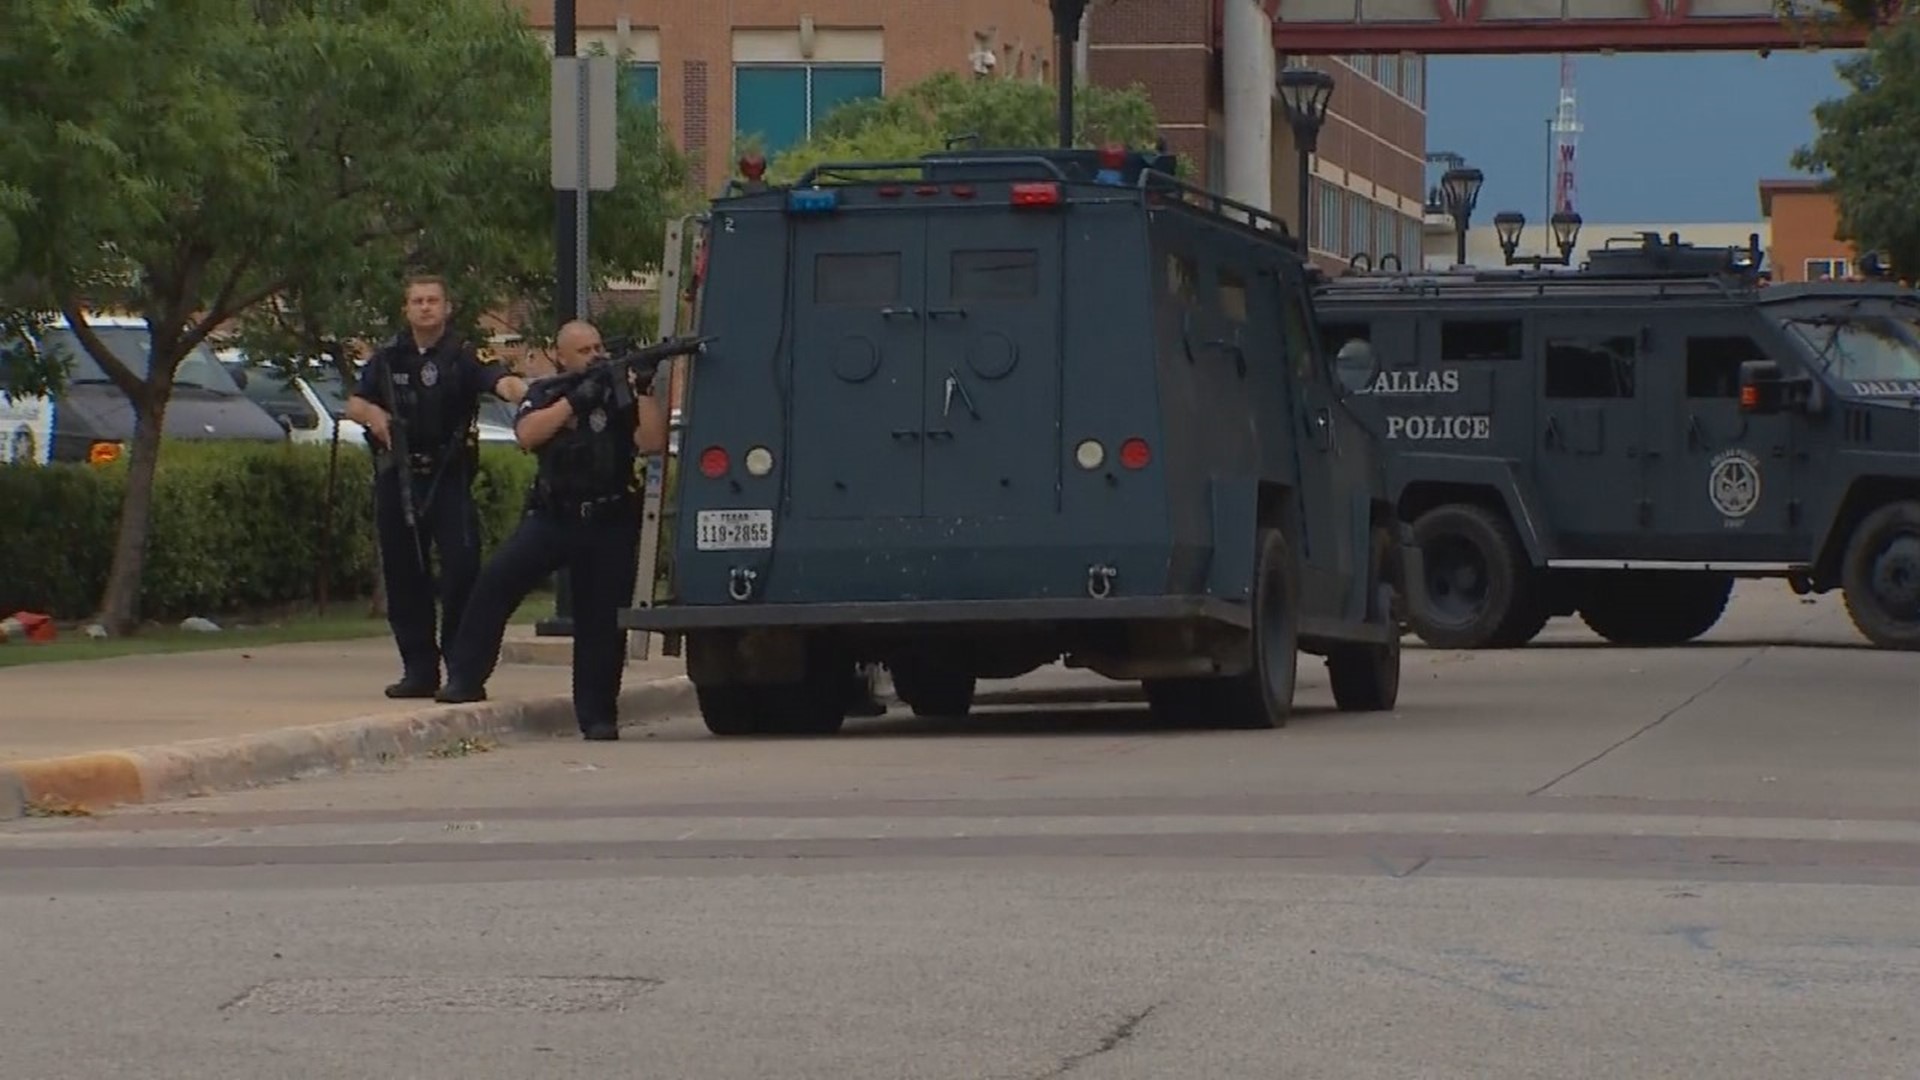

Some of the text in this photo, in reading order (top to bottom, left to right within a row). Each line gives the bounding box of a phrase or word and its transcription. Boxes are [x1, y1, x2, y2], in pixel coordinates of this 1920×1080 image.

[1354, 370, 1459, 395] ALLAS
[1851, 382, 1920, 396] DALLA
[1386, 415, 1490, 439] POLICE
